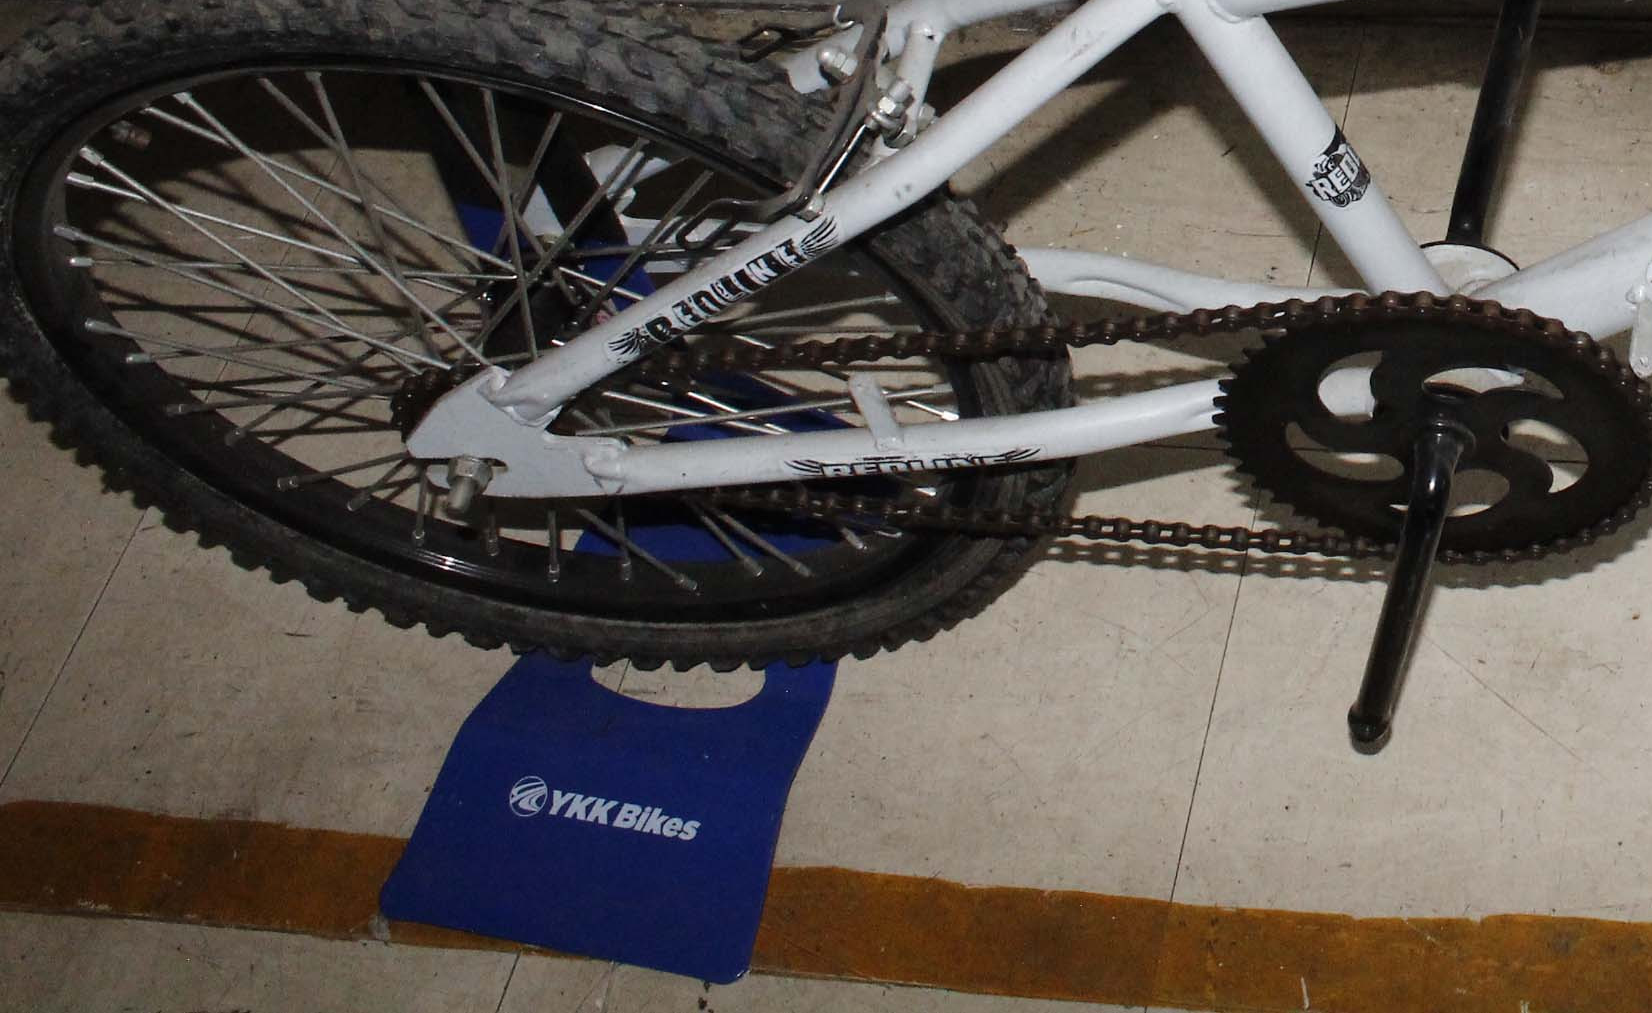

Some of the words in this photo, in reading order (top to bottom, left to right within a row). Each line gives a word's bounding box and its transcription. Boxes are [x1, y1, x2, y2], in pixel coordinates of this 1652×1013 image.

[643, 238, 807, 344] REDLINE
[547, 788, 619, 828] YKK
[615, 804, 702, 842] Bikes
